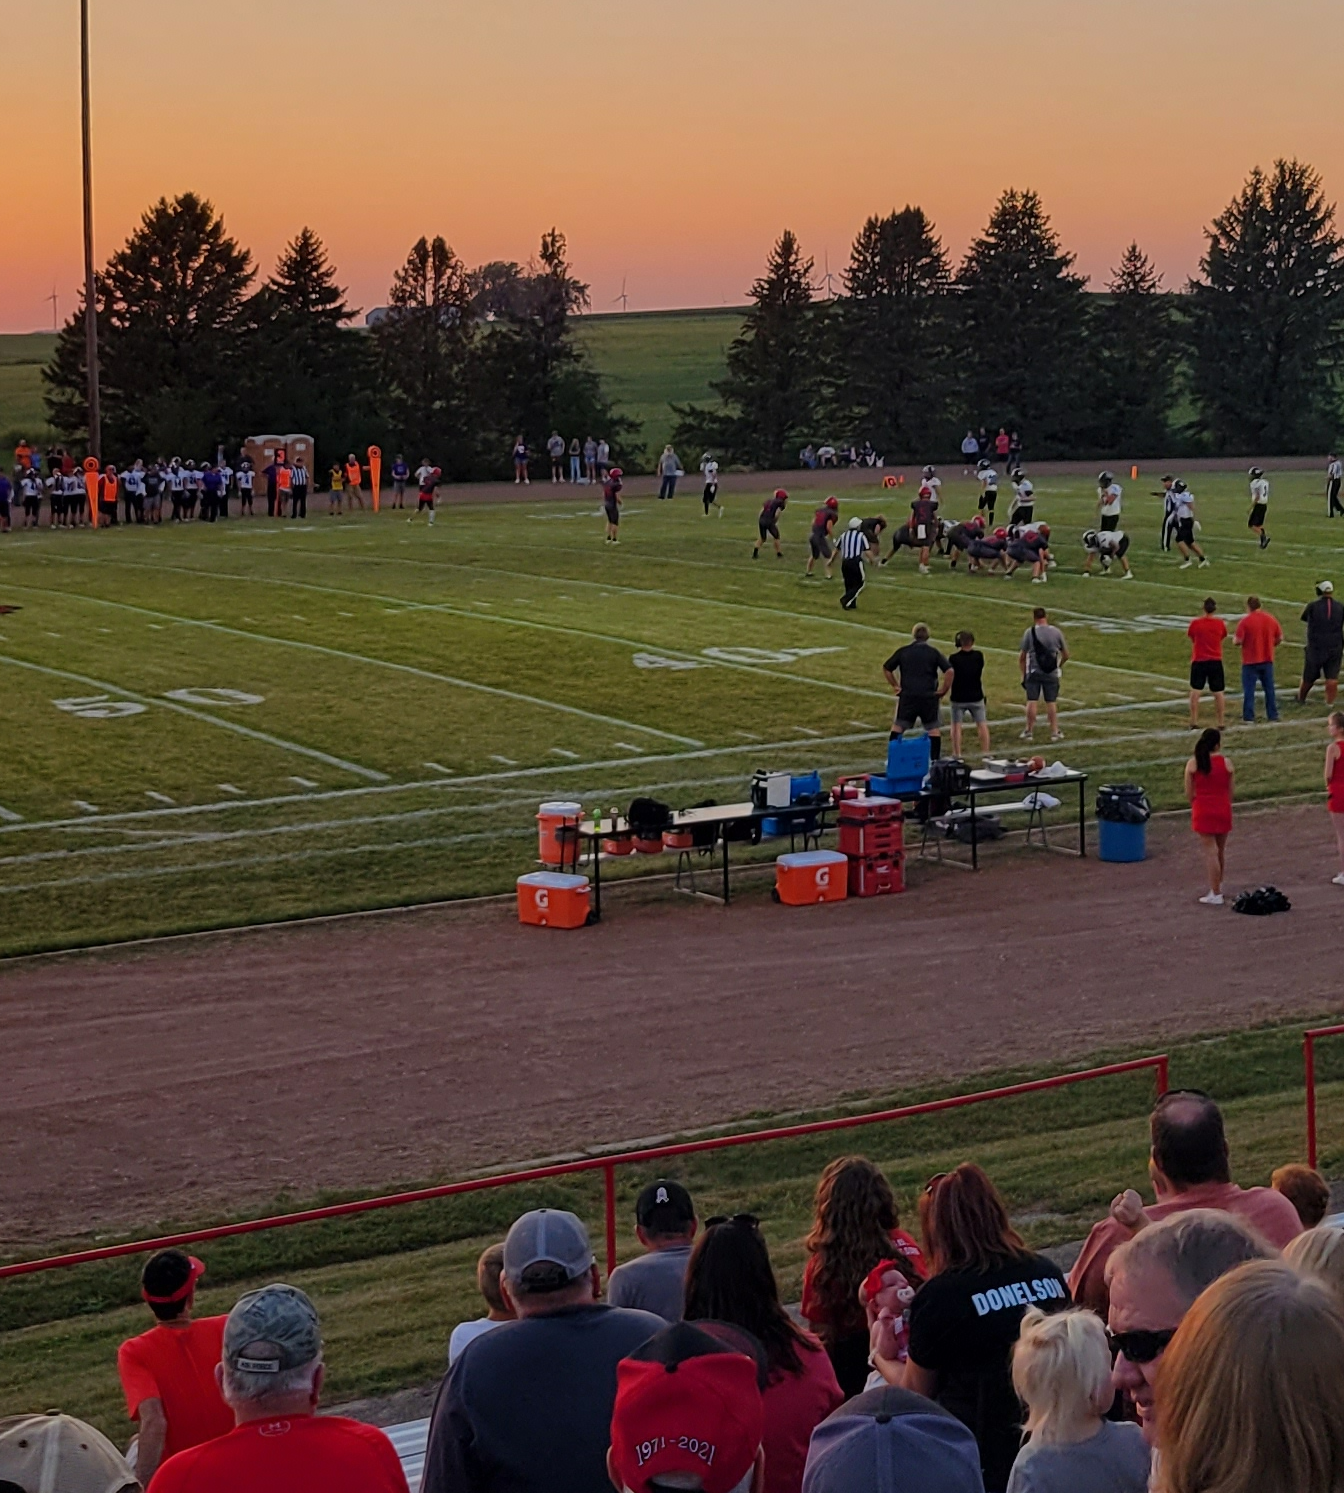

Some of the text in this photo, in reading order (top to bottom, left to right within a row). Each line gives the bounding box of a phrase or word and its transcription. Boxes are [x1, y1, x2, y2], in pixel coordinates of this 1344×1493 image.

[51, 688, 266, 718] 50
[815, 866, 830, 886] G
[535, 888, 549, 908] G
[971, 1278, 1066, 1317] DONELSON
[635, 1435, 716, 1467] 1971-2021
